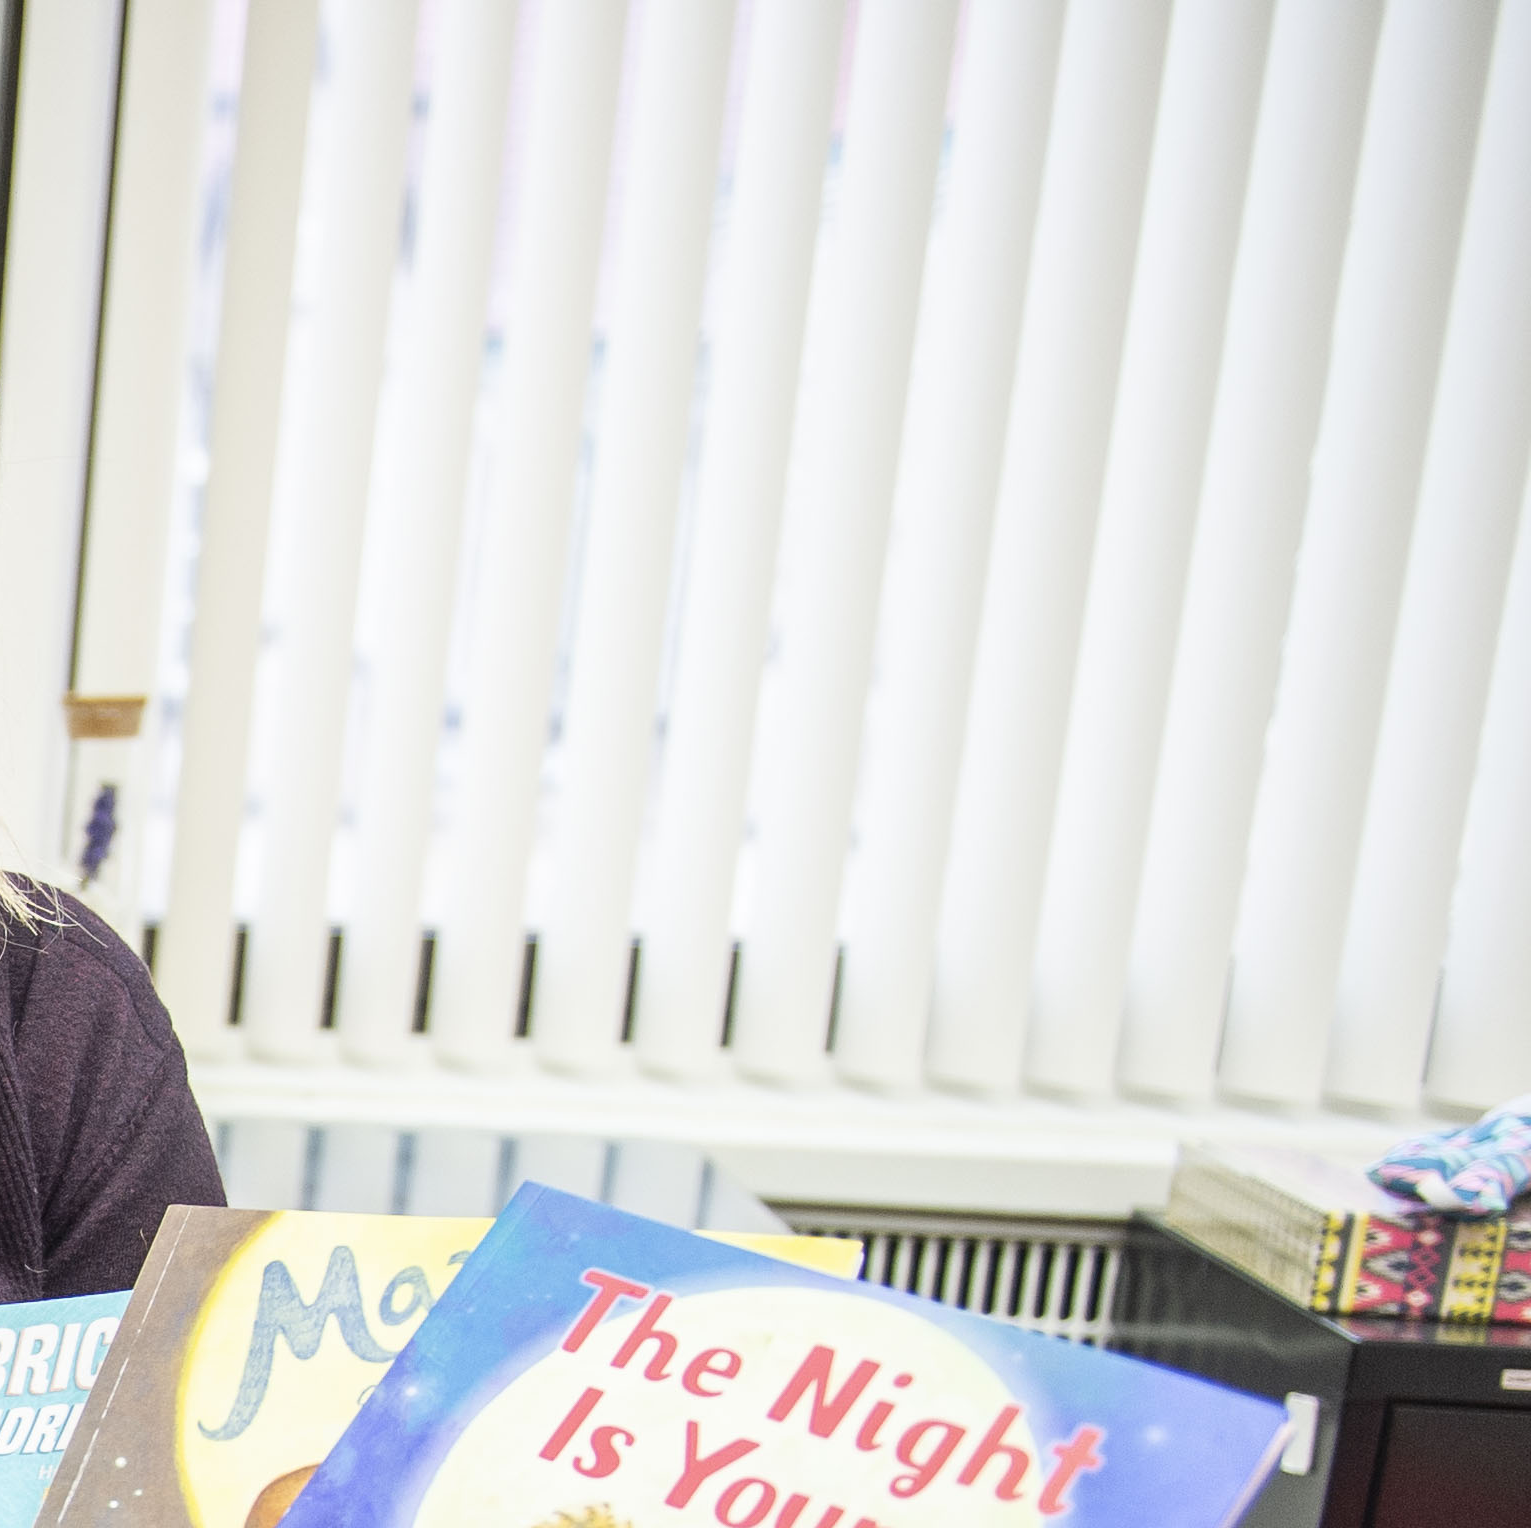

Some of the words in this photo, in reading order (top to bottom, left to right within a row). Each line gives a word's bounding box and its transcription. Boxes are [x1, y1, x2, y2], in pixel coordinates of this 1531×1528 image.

[198, 1244, 472, 1442] Ma
[538, 1386, 636, 1479] Is
[562, 1268, 743, 1397] The
[767, 1344, 1104, 1516] Night
